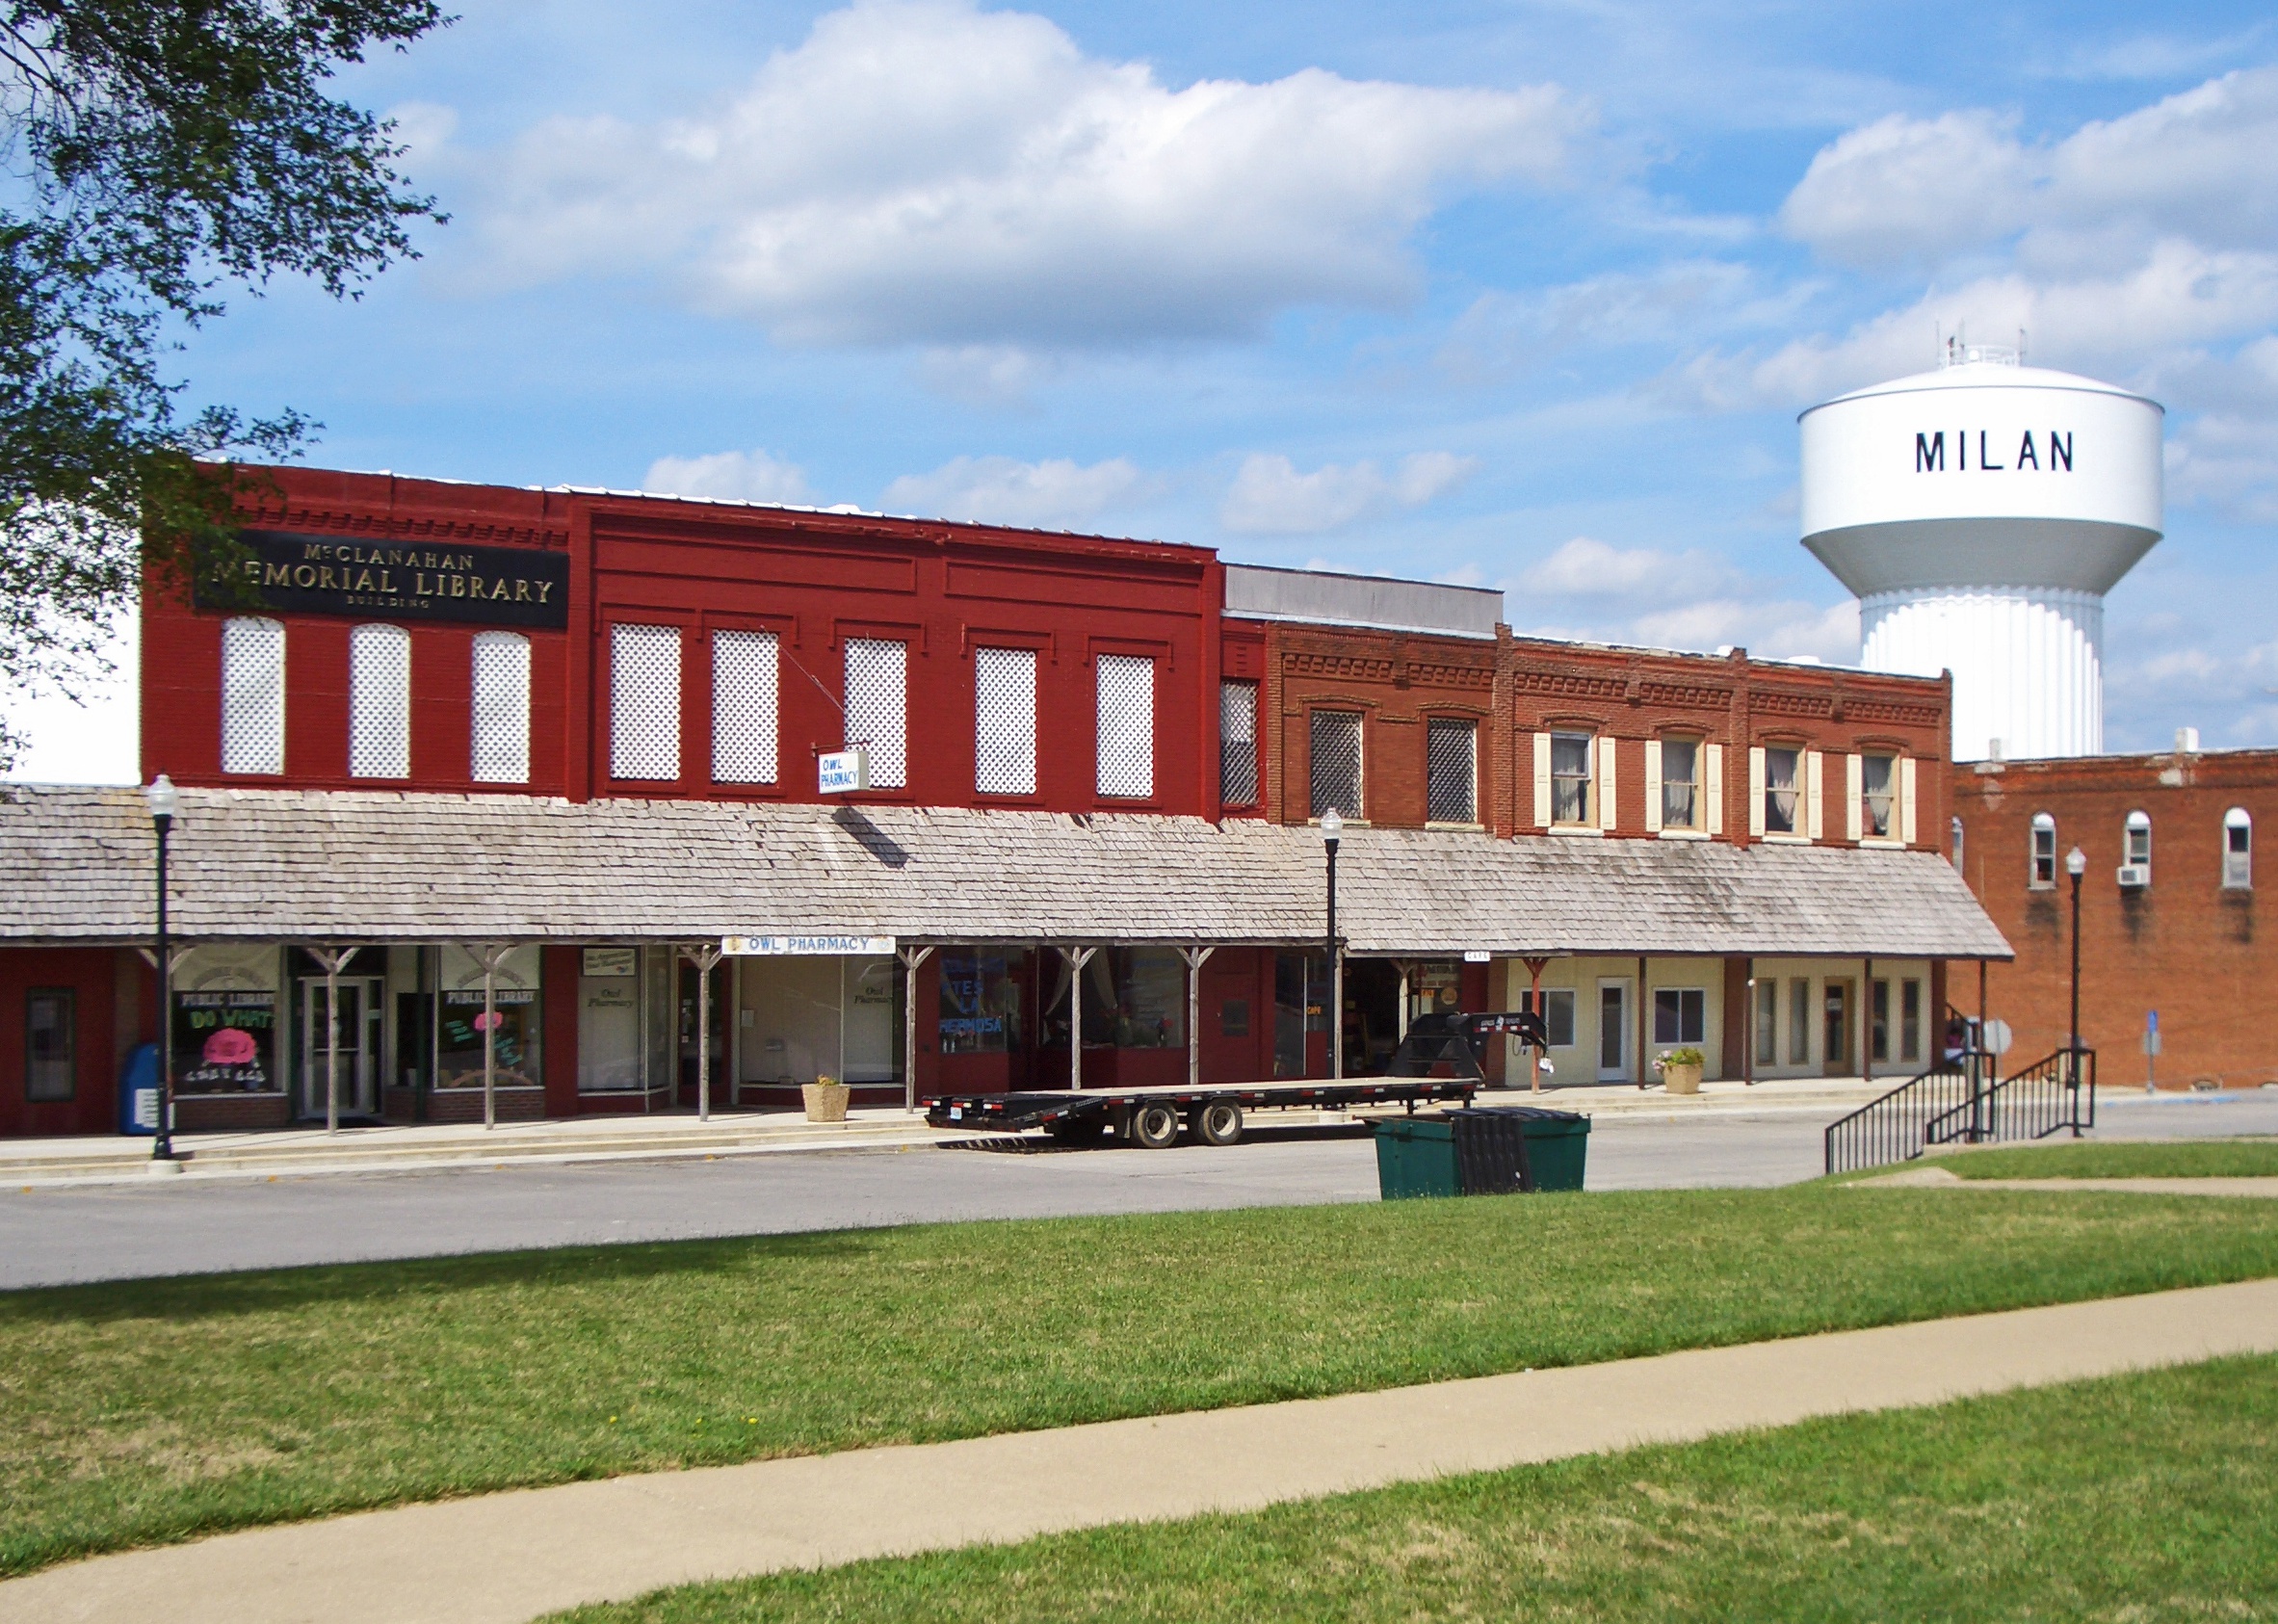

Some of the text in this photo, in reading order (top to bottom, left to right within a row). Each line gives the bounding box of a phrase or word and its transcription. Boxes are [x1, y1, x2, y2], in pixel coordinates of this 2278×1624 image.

[1916, 430, 2073, 473] MILAN
[415, 571, 555, 604] LIBRARY
[346, 594, 431, 609] BUILDING
[823, 758, 843, 772] OWL
[821, 771, 857, 787] PHARMACY
[749, 937, 870, 951] OWL PHARMACY
[182, 992, 224, 1007] PUBLIC
[601, 988, 622, 998] Owl
